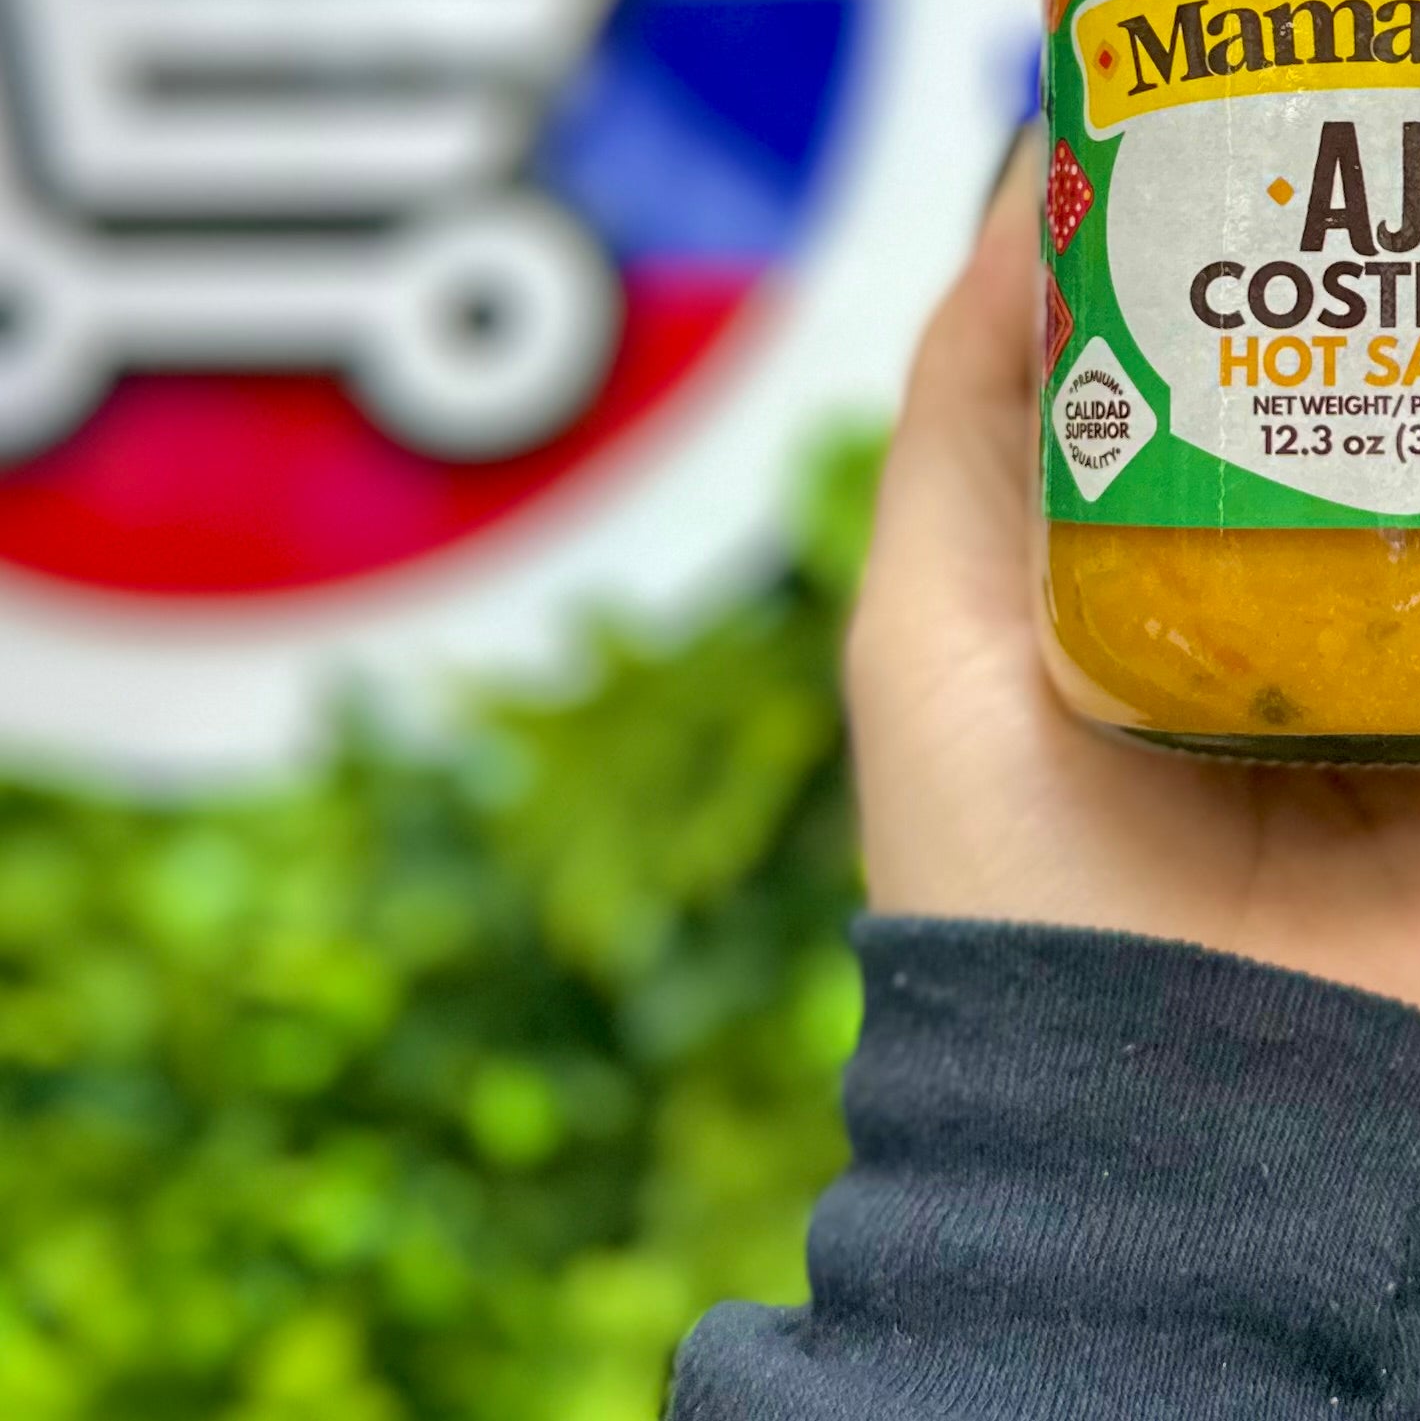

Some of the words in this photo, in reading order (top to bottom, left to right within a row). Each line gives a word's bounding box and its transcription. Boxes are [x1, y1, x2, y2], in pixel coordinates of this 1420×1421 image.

[1220, 335, 1348, 387] HOT
[1072, 370, 1120, 394] PREMIUM
[1065, 400, 1131, 420] CALIDAD
[1252, 395, 1298, 416] NET
[1065, 421, 1131, 440] SUPERIOR
[1260, 424, 1334, 457] 12.3
[1342, 434, 1386, 456] oz
[1070, 445, 1118, 470] QUALITY
